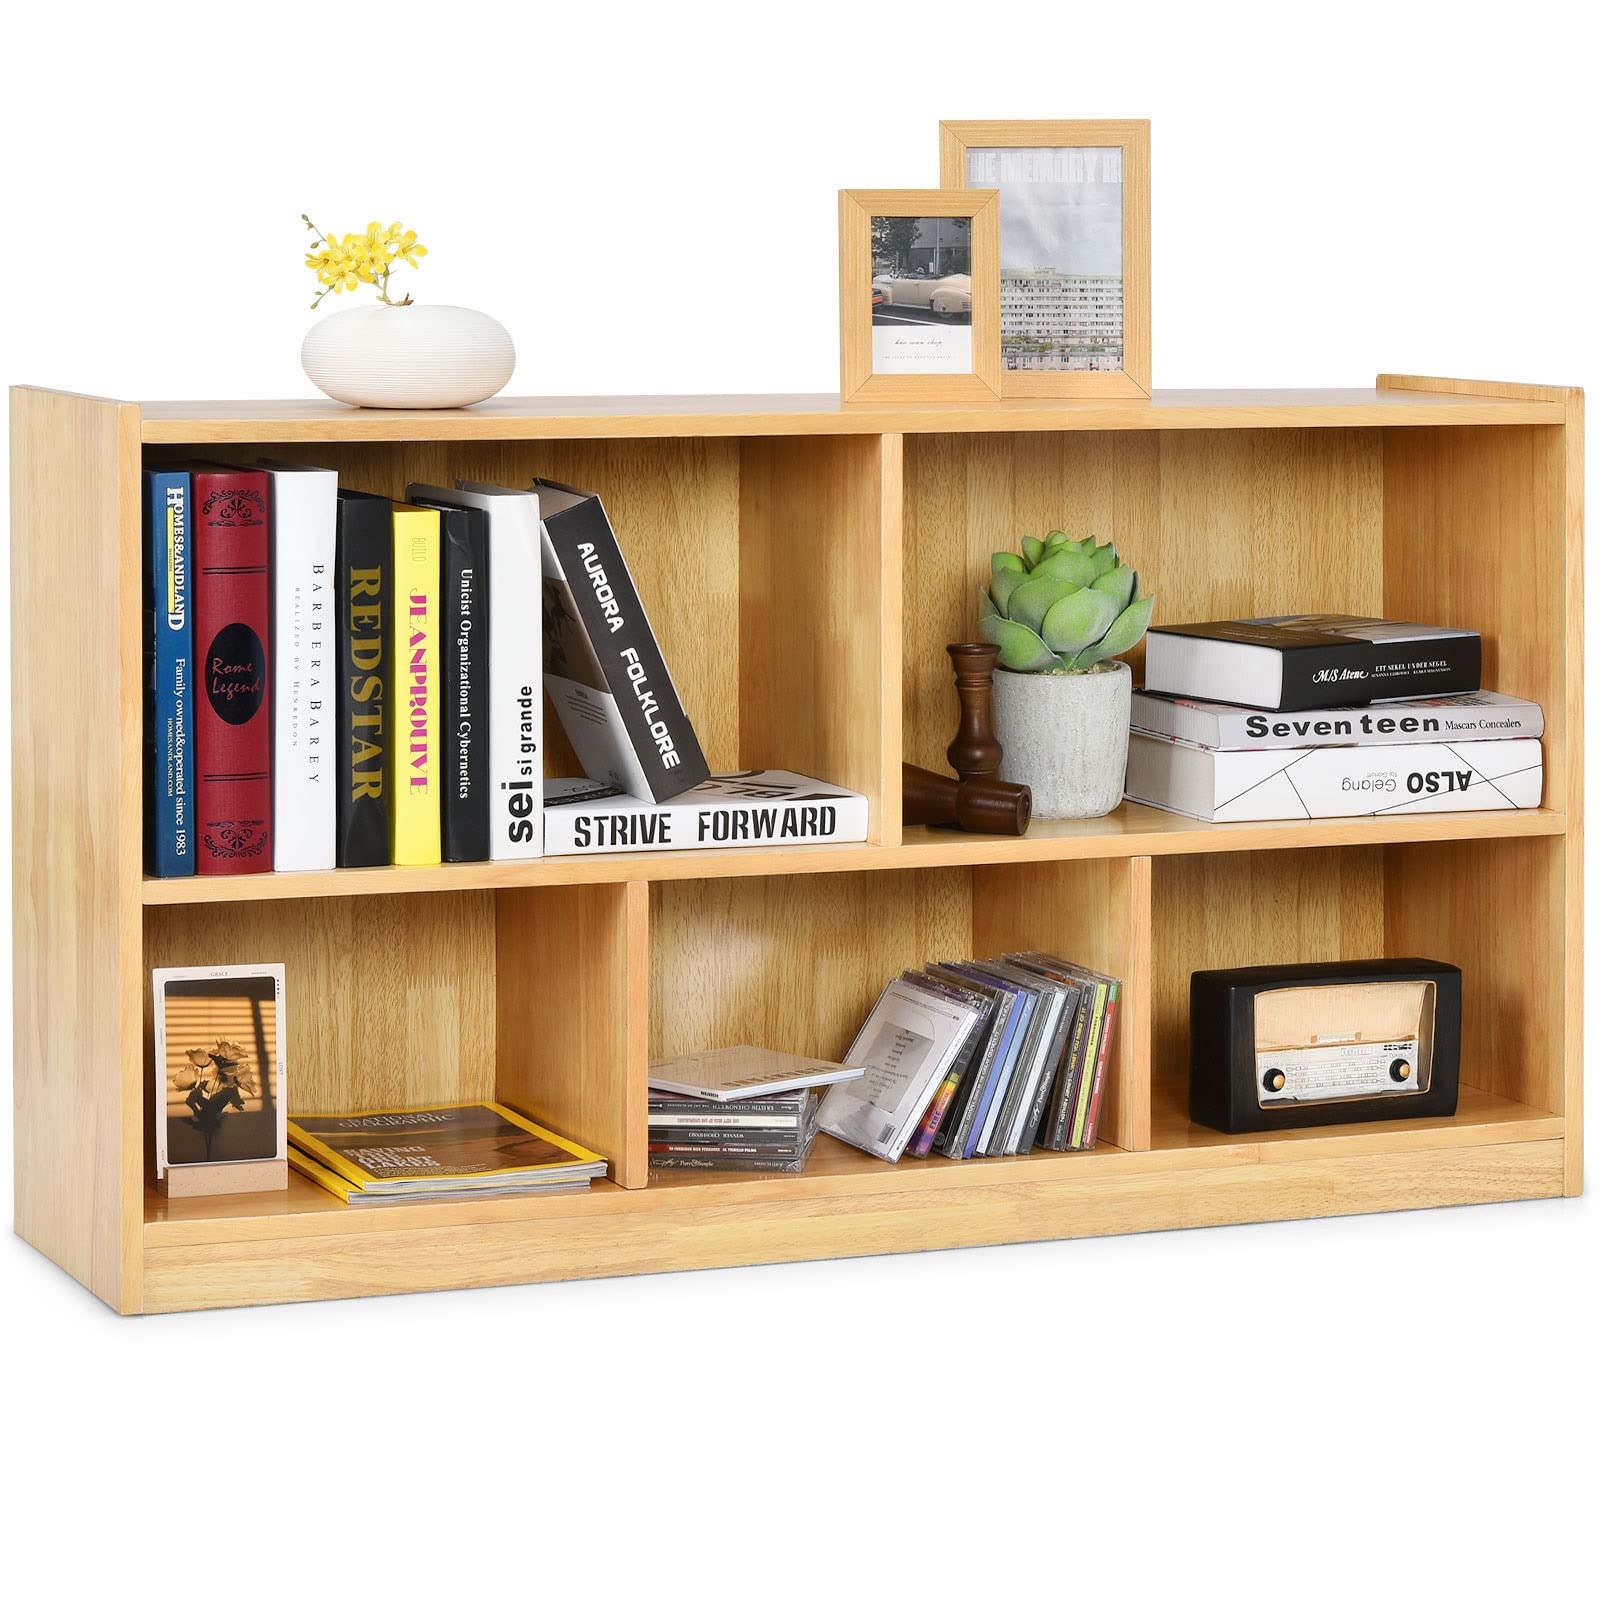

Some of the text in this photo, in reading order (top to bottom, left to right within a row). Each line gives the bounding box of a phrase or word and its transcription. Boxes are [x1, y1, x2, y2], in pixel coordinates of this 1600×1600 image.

[167, 487, 185, 631] HOMES&ANDLAND
[212, 658, 254, 673] Rome
[212, 679, 261, 699] Legend
[293, 657, 300, 671] BY
[308, 564, 325, 784] BARBERA BAREY
[349, 565, 383, 802] REDSTAR
[408, 587, 430, 796] JEANPROUVE
[457, 568, 473, 800] Unicist Organizational Cybernetics
[577, 541, 625, 634] AURORA
[619, 647, 681, 770] FOLKLORE
[1312, 667, 1369, 683] M/S Atene
[1445, 718, 1478, 731] Mascars
[1479, 715, 1522, 730] Concealers
[173, 658, 187, 856] Family owned&operated since 1983
[501, 685, 537, 843] sei si grande
[574, 805, 837, 848] STRIVE FORWARD
[1341, 769, 1473, 794] ALSO Gelang
